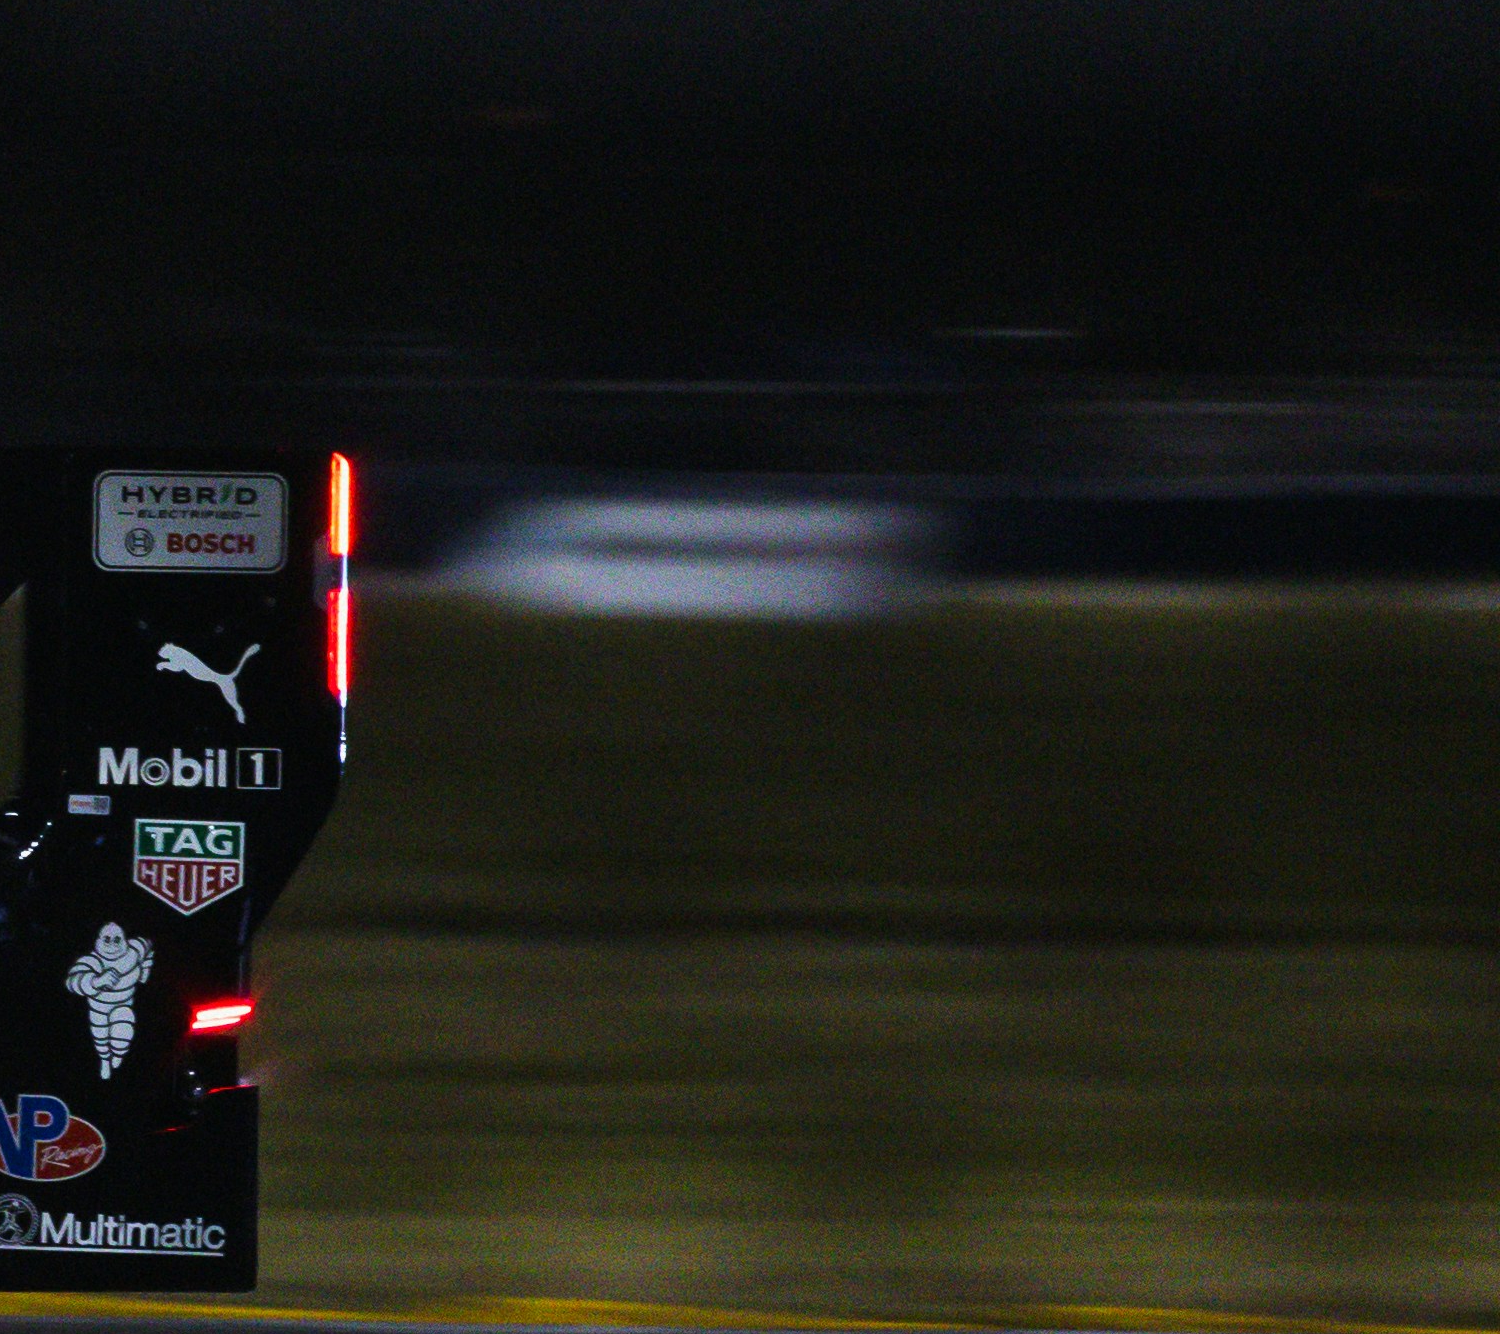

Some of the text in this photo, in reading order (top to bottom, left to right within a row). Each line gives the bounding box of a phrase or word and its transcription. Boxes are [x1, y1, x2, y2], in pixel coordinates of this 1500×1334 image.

[121, 482, 257, 505] HYBRID
[167, 532, 256, 554] BOSCH
[98, 746, 228, 788] Mobil
[145, 825, 234, 855] TAG
[141, 863, 236, 907] HEUER
[40, 1143, 104, 1168] Racing
[40, 1211, 227, 1250] Multimatic
